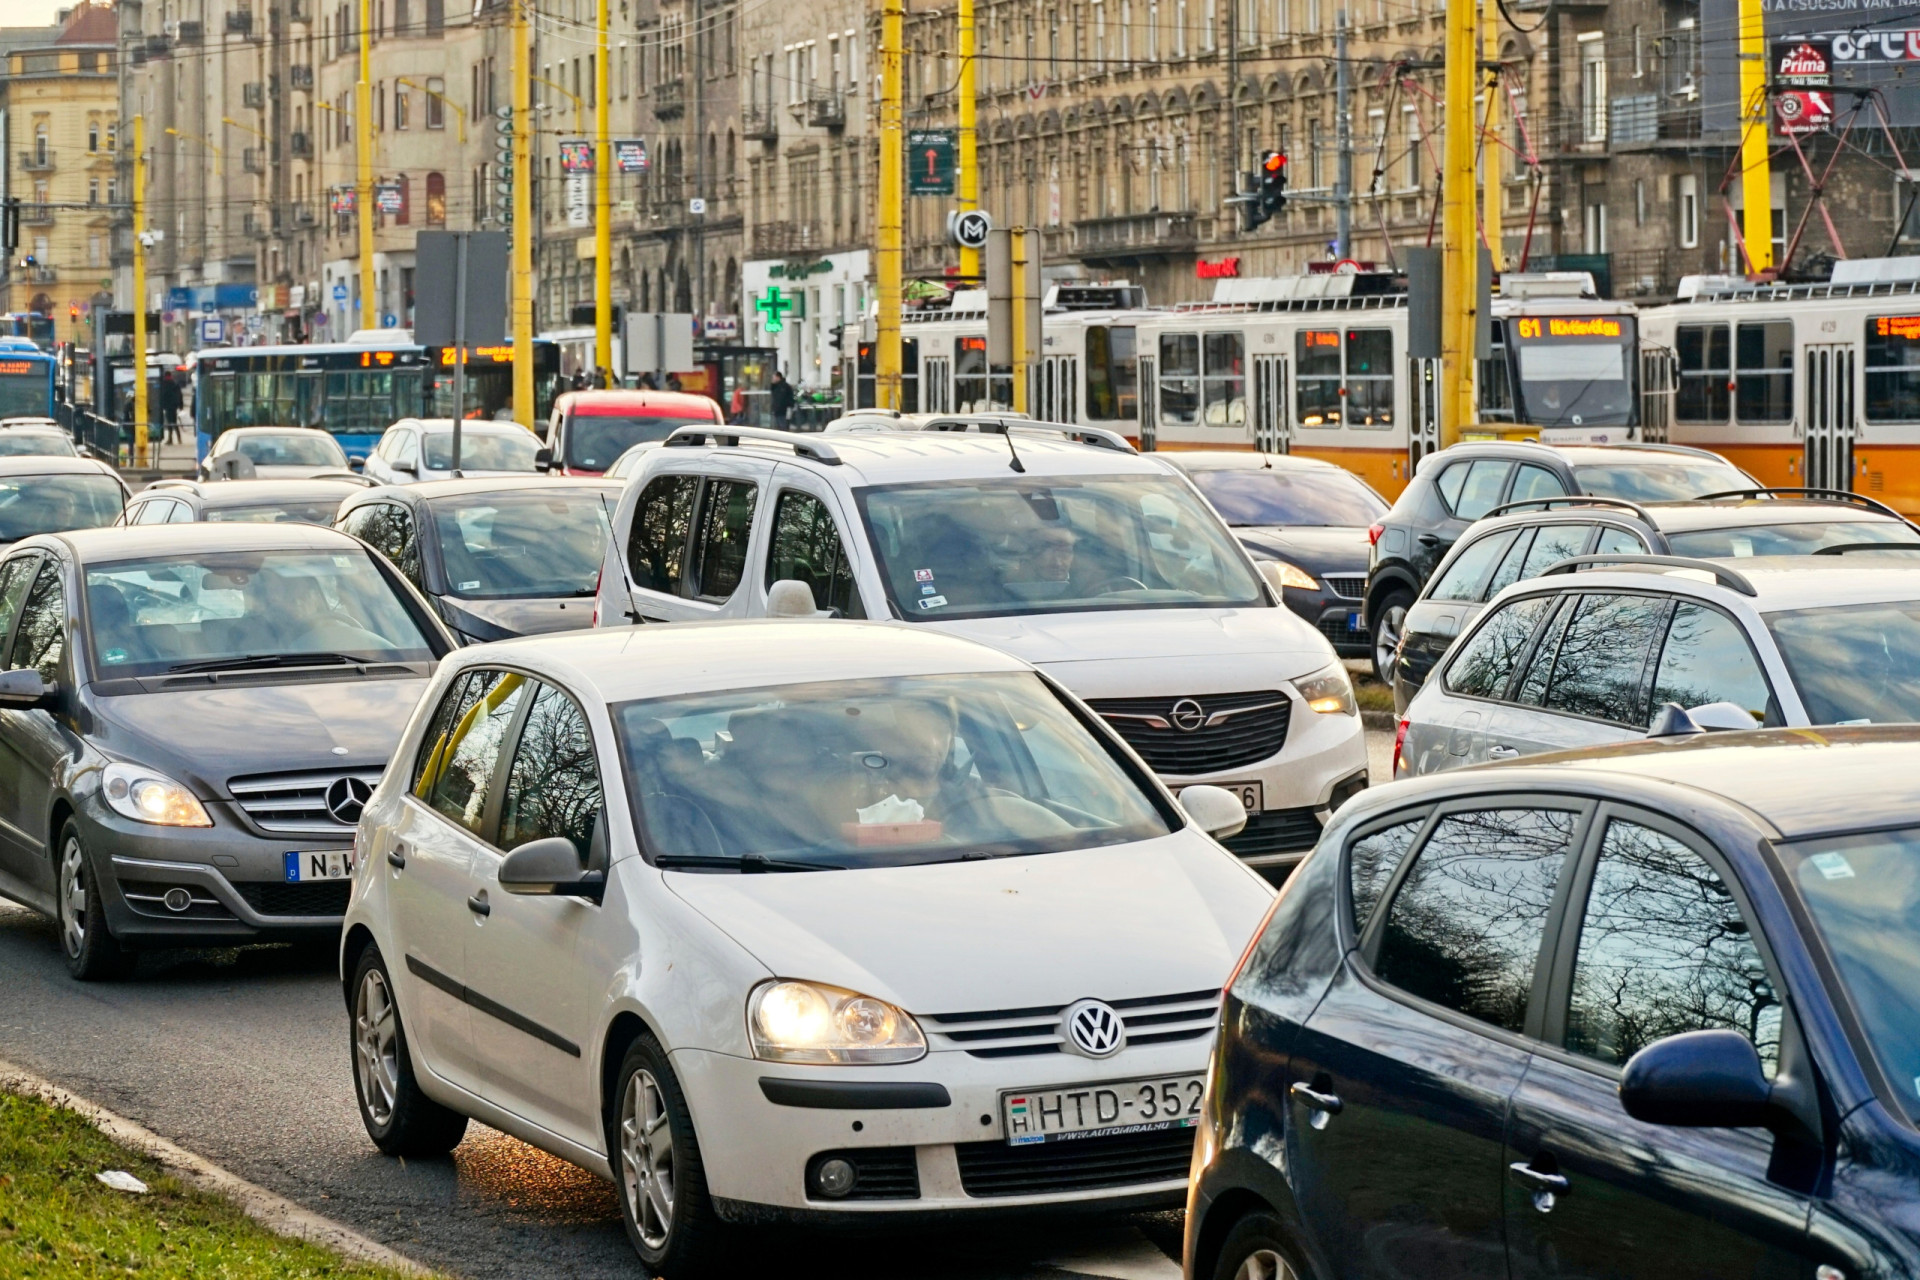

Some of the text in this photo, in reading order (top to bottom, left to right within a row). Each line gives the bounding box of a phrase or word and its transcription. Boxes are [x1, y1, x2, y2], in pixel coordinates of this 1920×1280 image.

[1780, 58, 1826, 73] Prima
[1519, 319, 1541, 338] 61
[290, 869, 297, 877] D
[1012, 1080, 1204, 1133] H HTD-352
